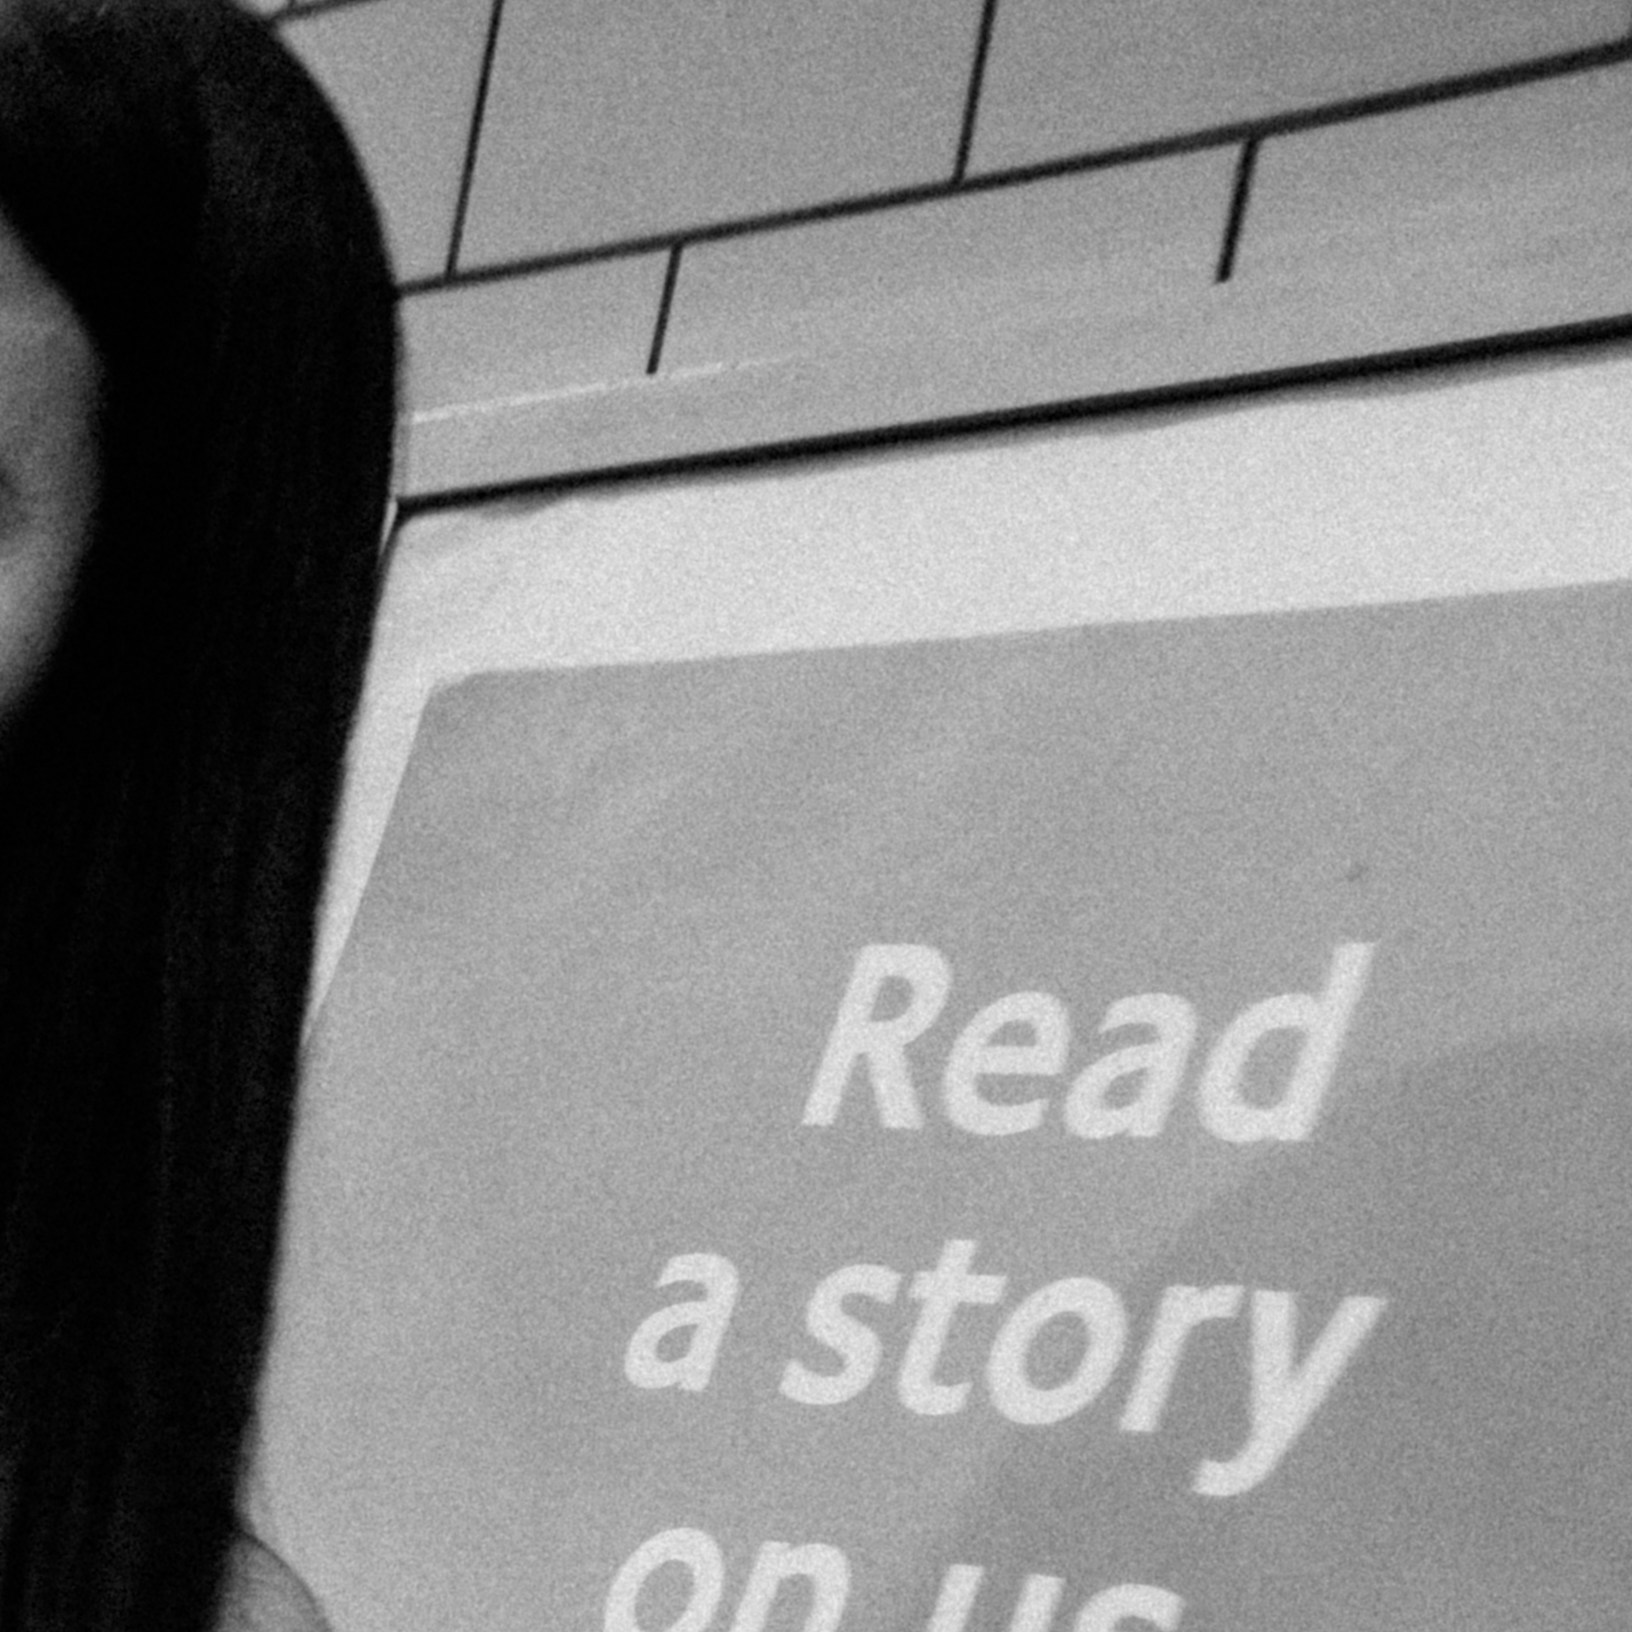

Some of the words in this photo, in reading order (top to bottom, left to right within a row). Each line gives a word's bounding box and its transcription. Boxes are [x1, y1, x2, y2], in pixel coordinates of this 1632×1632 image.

[801, 942, 1379, 1143] Read
[622, 1252, 739, 1392] a
[779, 1239, 1388, 1497] story
